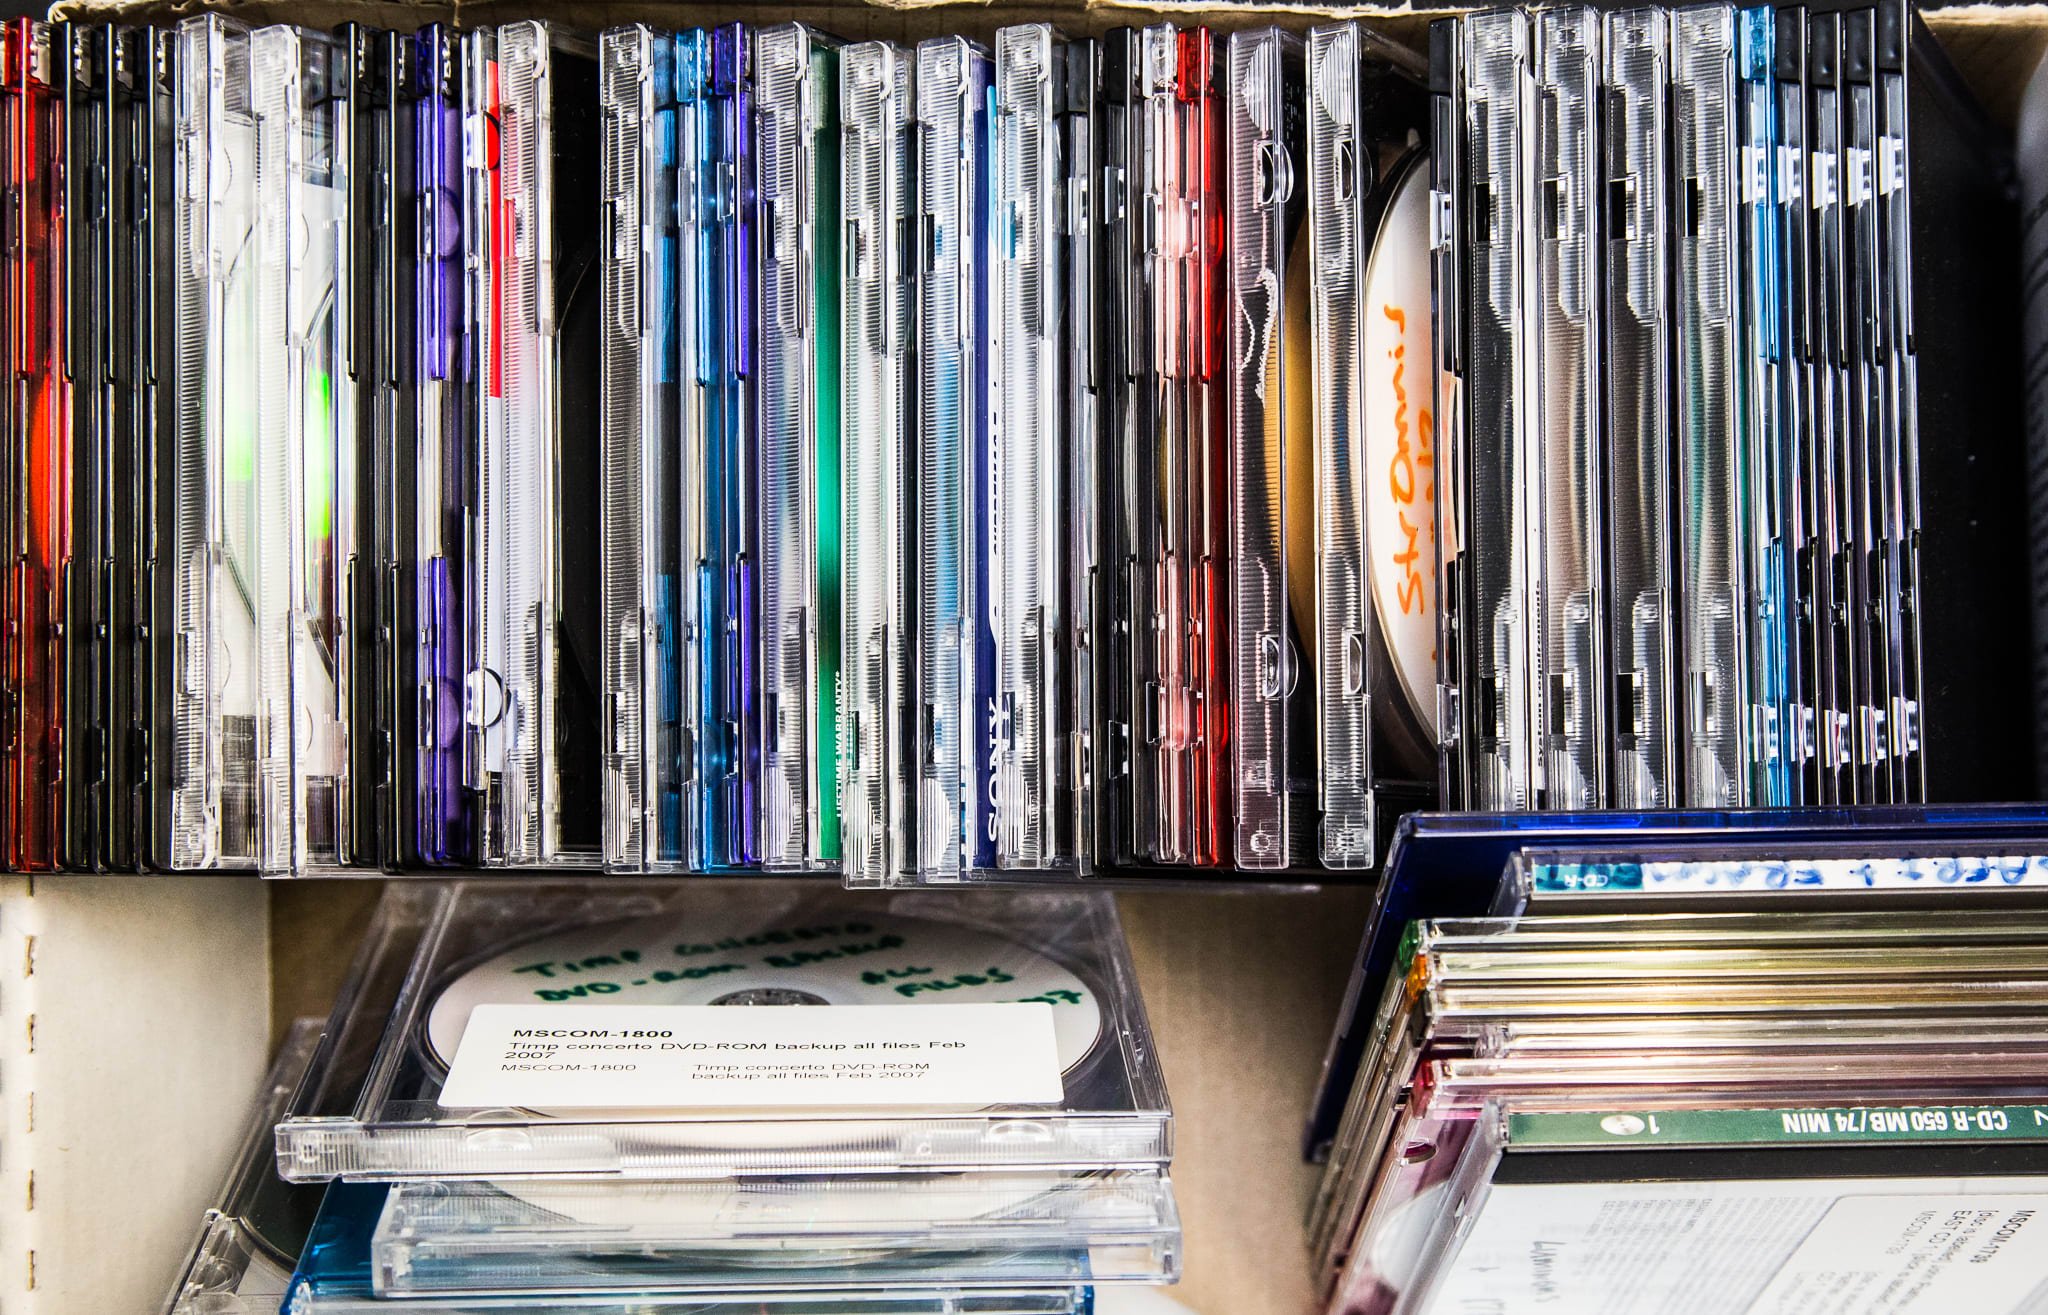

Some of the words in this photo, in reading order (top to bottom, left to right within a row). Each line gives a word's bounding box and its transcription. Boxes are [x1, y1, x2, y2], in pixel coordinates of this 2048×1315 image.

[1564, 874, 1609, 888] CD-R
[513, 1030, 673, 1038] MSCOM-1800
[509, 1042, 560, 1051] Timp
[660, 1042, 767, 1050] DVD-ROM
[775, 1042, 847, 1051] backup
[853, 1042, 875, 1050] all
[929, 1041, 966, 1049] Feb
[500, 1064, 638, 1072] MSCOM-1800
[693, 1063, 739, 1072] Timp
[745, 1063, 825, 1071] concerto
[832, 1063, 931, 1071] DVD-ROM
[692, 1072, 761, 1080] backup
[836, 1071, 873, 1079] Feb
[879, 1071, 927, 1079] 2007
[1648, 1114, 1661, 1136] 1
[1781, 1111, 1831, 1134] MIN
[1911, 1109, 1948, 1131] 650
[1952, 1109, 2008, 1132] CD-R
